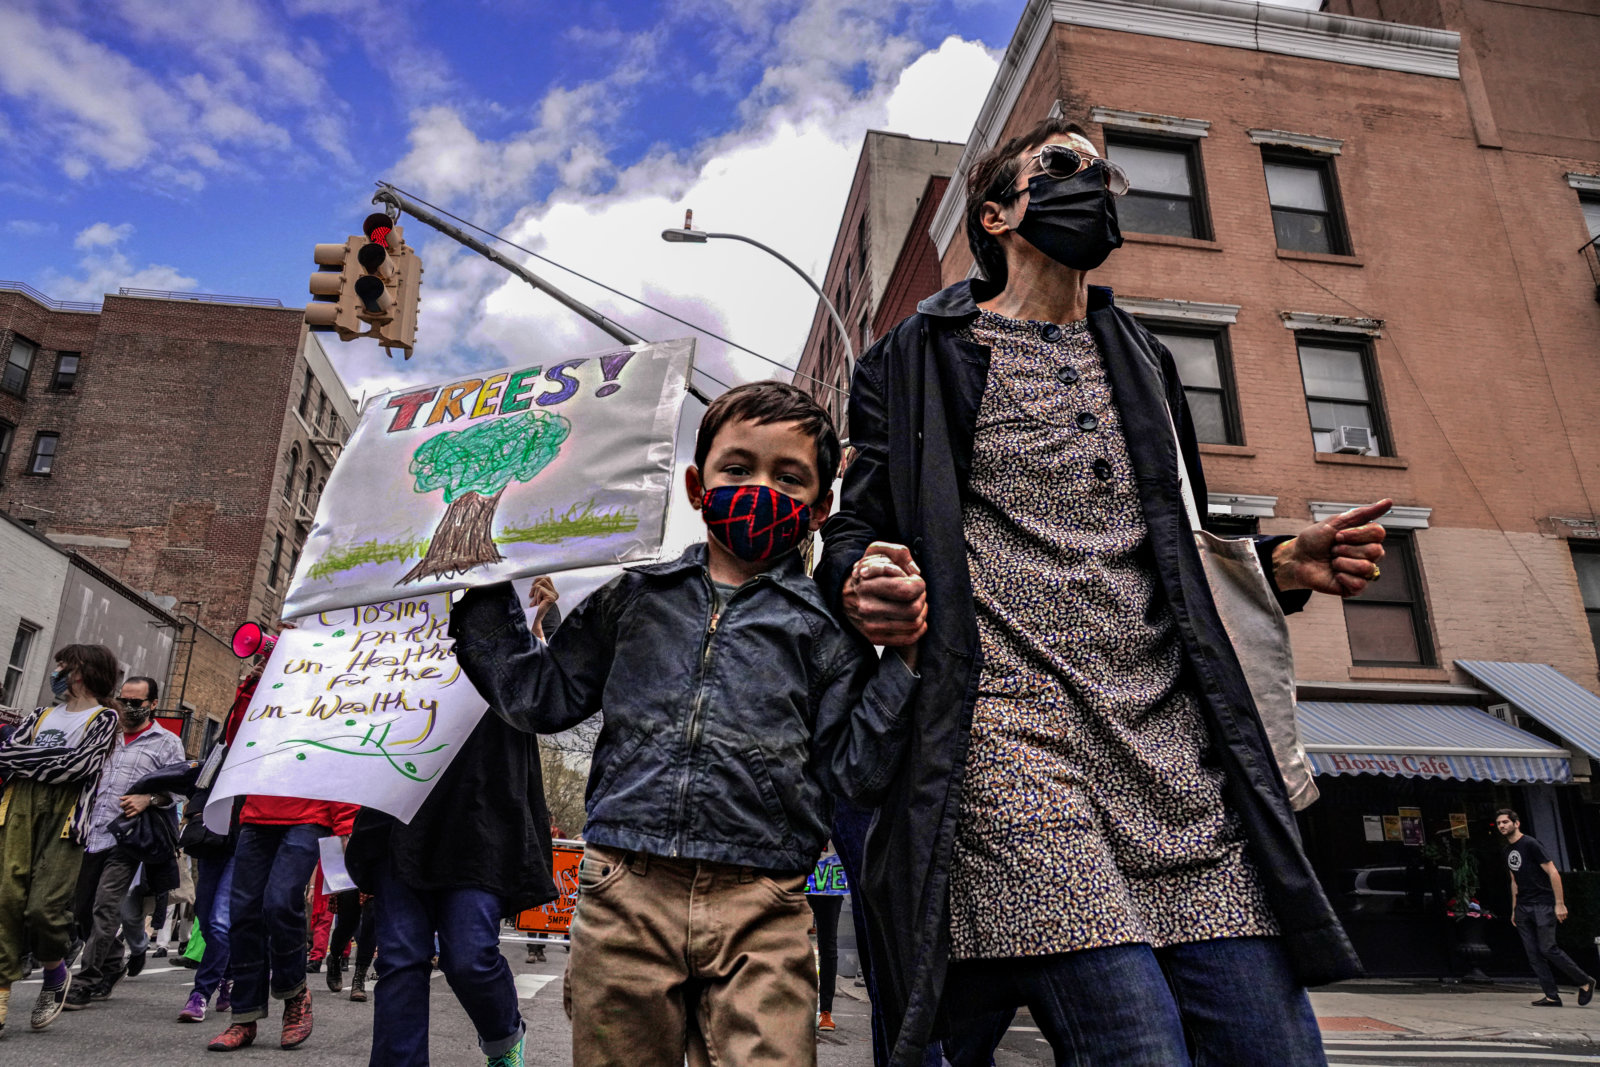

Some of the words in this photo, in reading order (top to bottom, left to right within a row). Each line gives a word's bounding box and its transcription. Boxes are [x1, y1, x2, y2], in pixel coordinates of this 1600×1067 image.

[384, 350, 637, 433] TREES!
[384, 667, 442, 683] the
[1330, 754, 1400, 772] Horus
[1402, 755, 1450, 774] Cafe
[804, 863, 847, 892] VE
[548, 915, 569, 925] 5MPH
